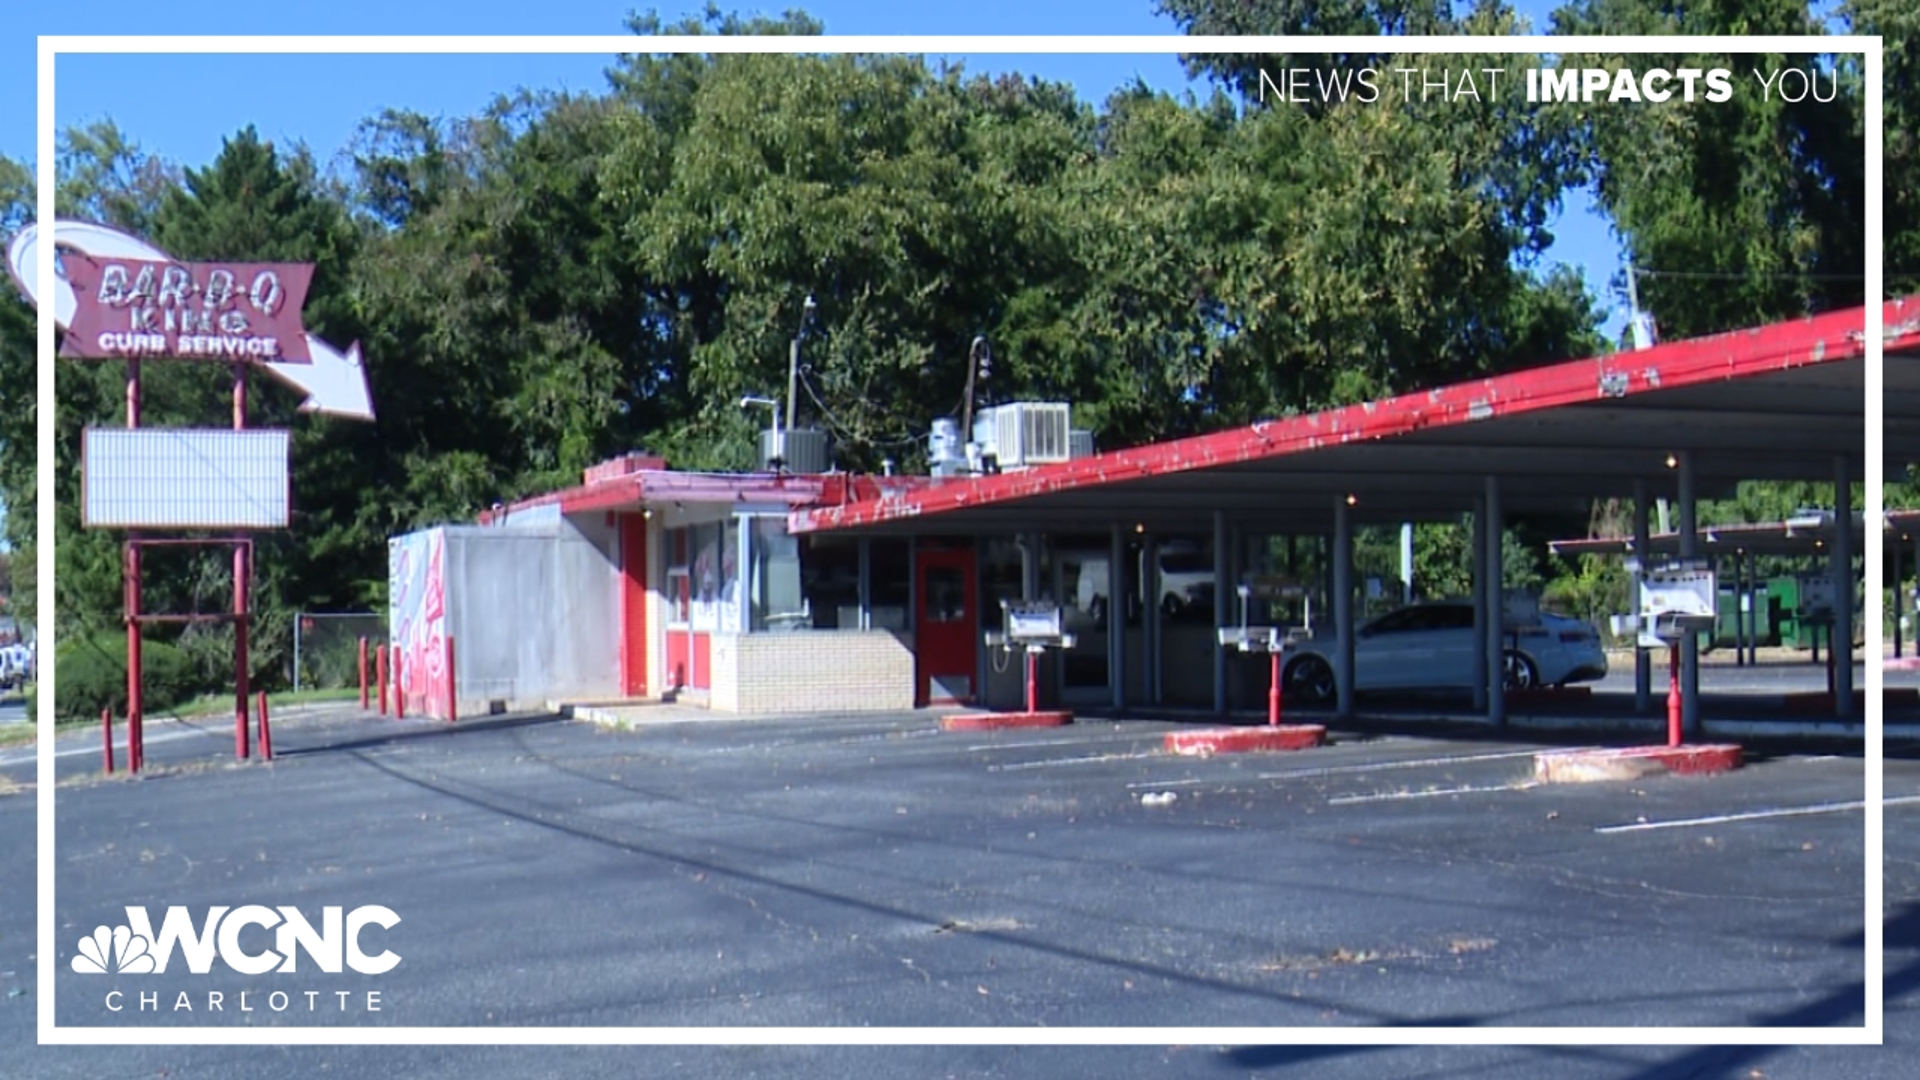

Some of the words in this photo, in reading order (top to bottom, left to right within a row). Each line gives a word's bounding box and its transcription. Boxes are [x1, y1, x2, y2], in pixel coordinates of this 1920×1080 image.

[130, 305, 249, 333] KING
[98, 331, 166, 351] CURB
[178, 334, 279, 356] SERVICE
